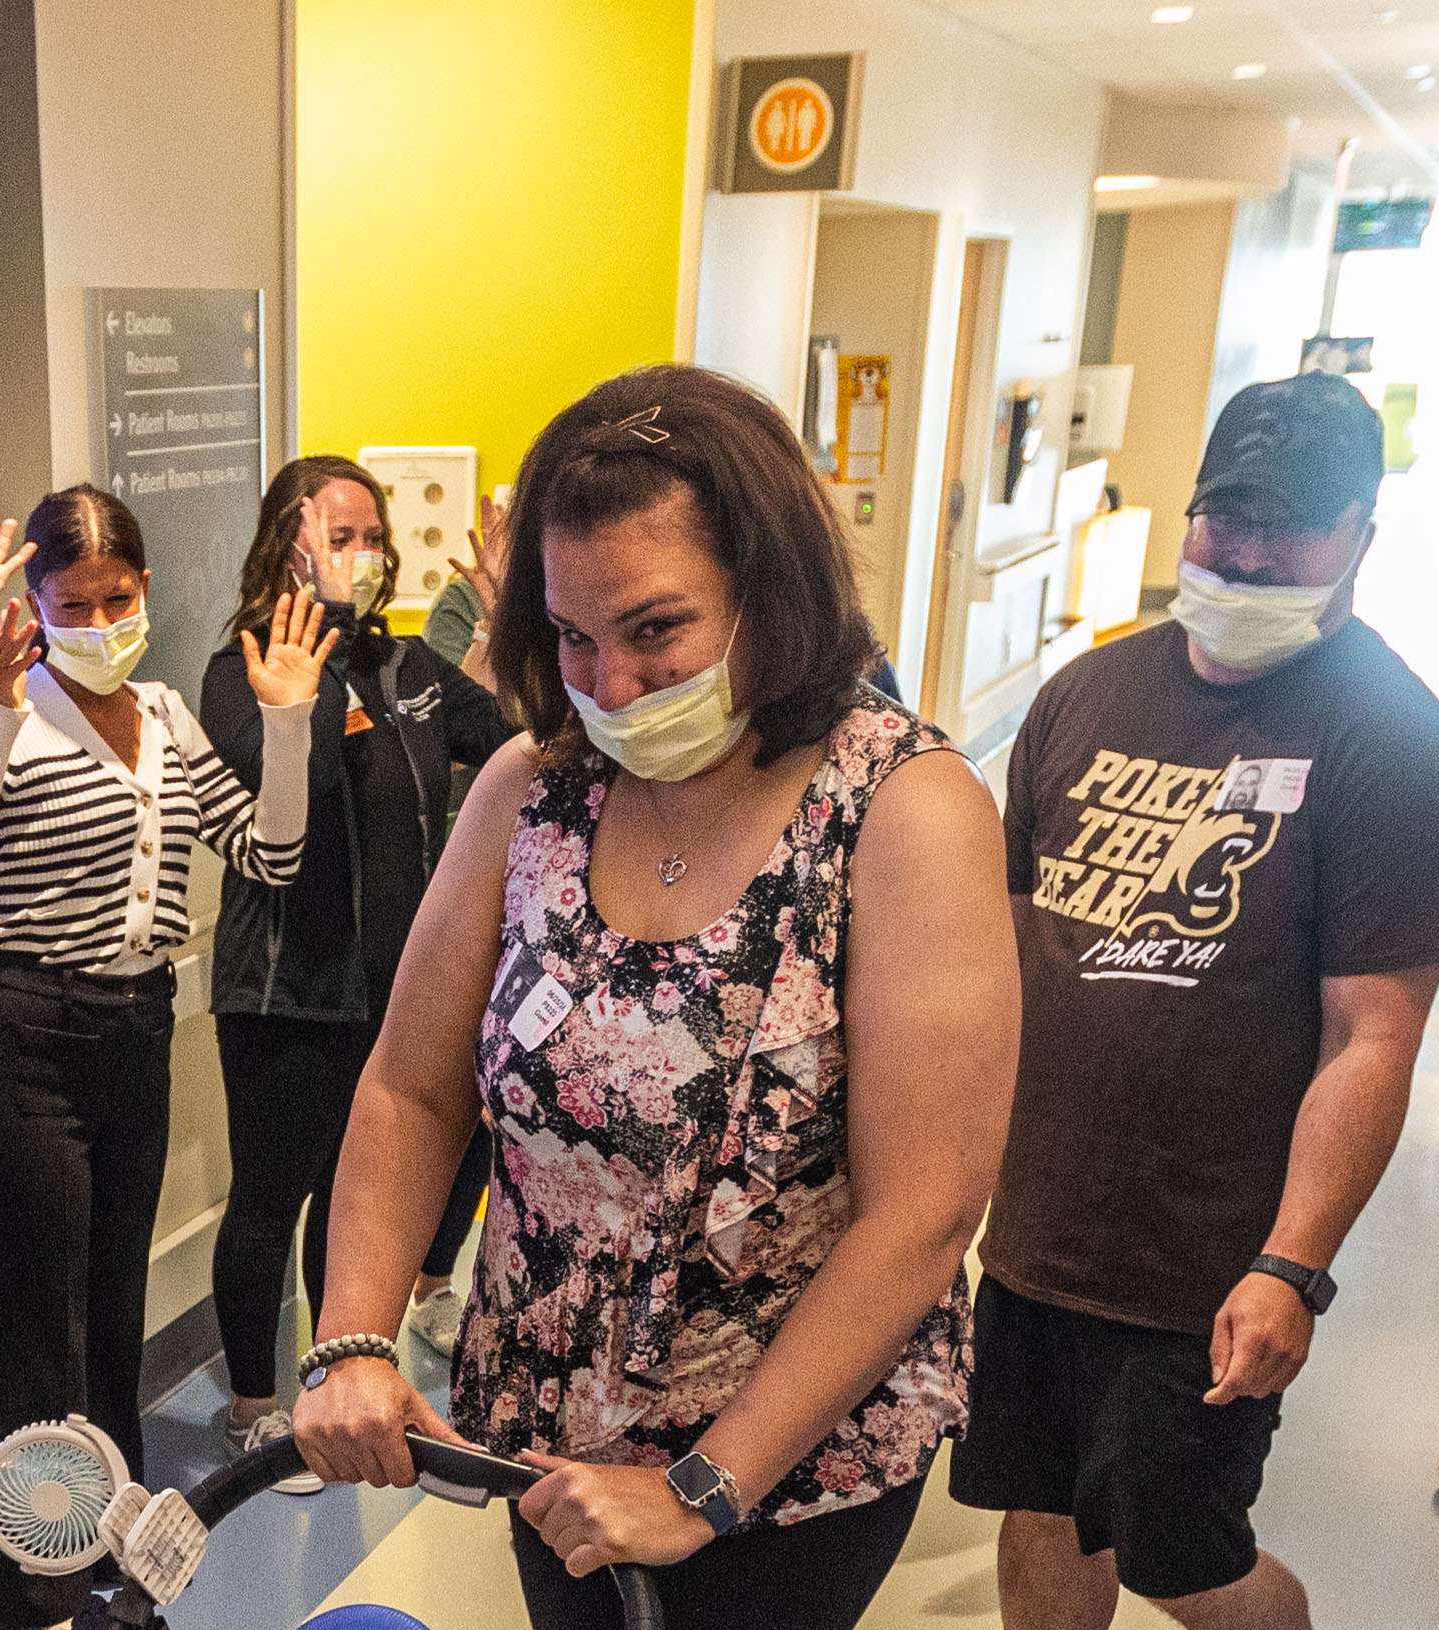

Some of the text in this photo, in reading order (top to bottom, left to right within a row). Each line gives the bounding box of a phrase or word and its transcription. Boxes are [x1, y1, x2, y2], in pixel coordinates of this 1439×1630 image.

[1063, 806, 1183, 876] THE
[1032, 856, 1146, 929] BEAR
[1079, 939, 1226, 969] I DARE YA!
